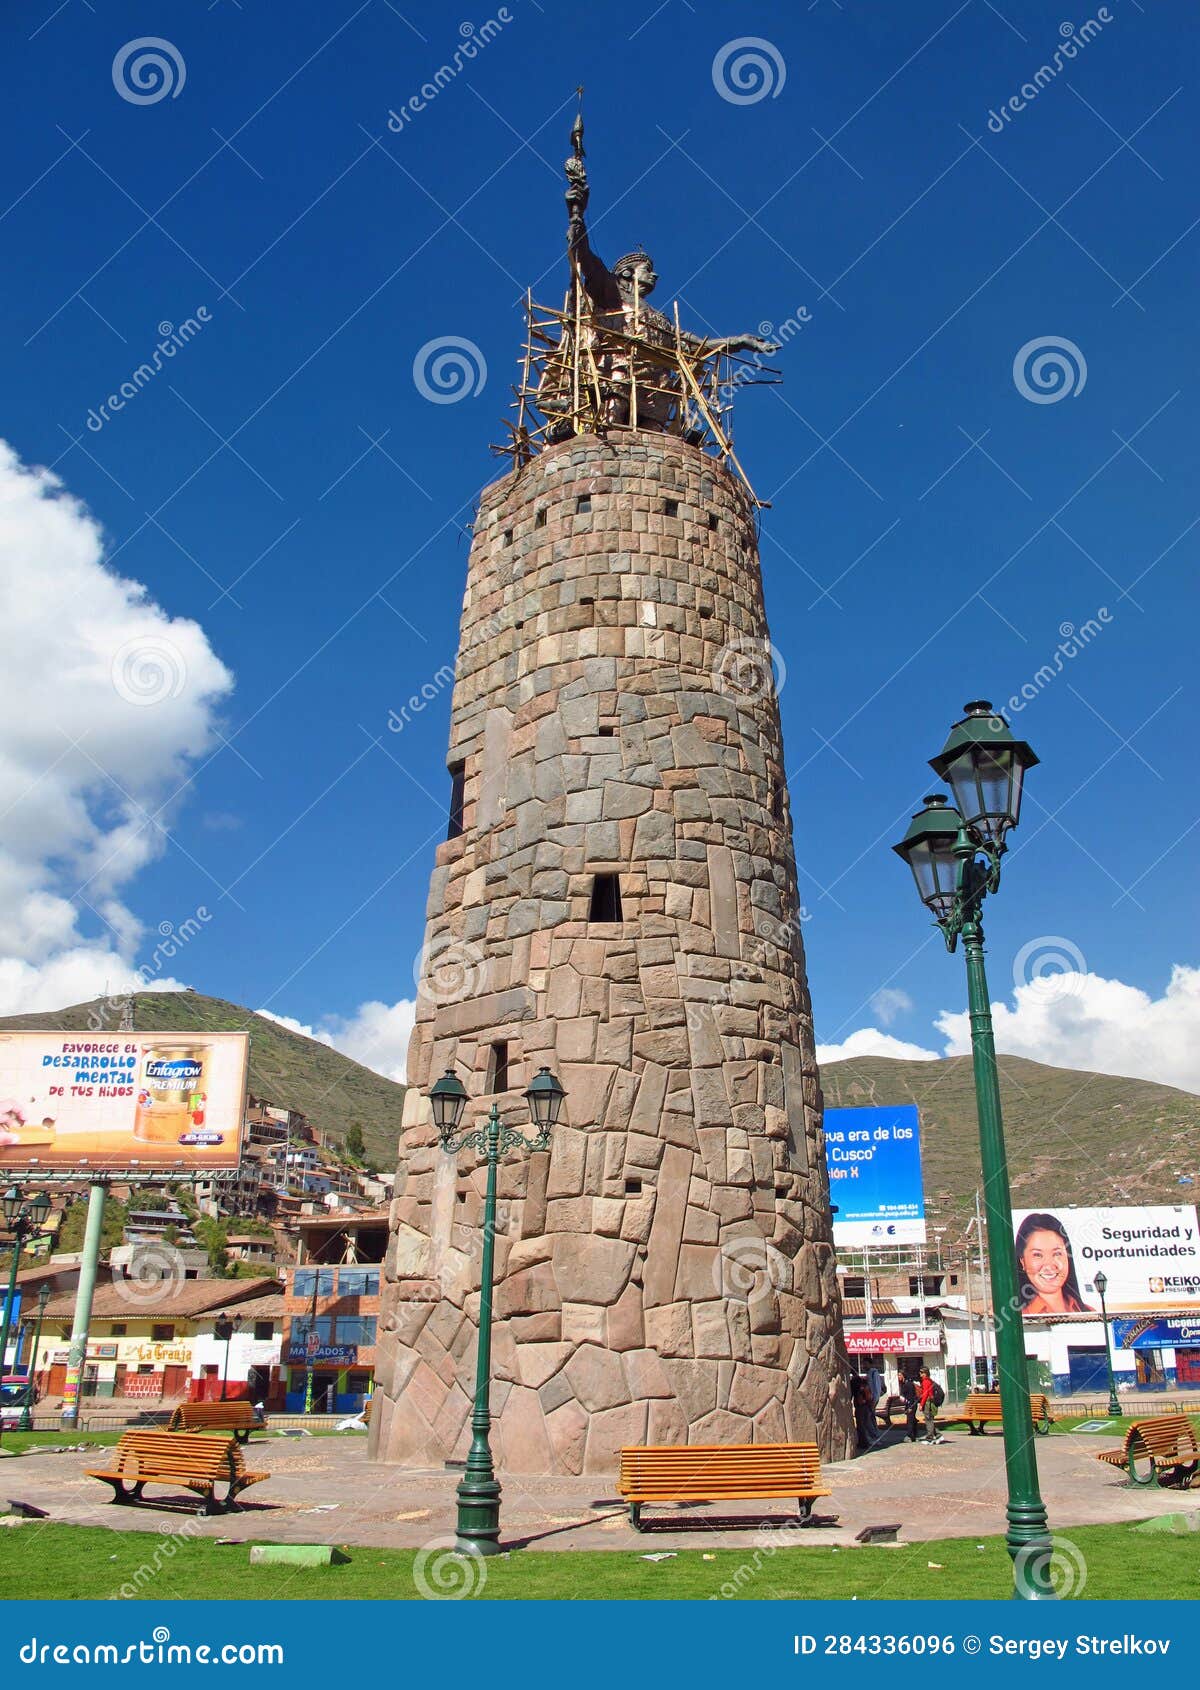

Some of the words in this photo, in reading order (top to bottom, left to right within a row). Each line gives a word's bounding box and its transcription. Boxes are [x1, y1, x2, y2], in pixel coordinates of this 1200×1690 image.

[147, 1063, 201, 1078] Enfagrow
[848, 1130, 870, 1141] era
[873, 1127, 889, 1140] de
[893, 1126, 913, 1139] los
[1102, 1226, 1180, 1242] Seguridad
[1184, 1228, 1193, 1240] y
[1082, 1244, 1196, 1261] Oportunidades
[1164, 1276, 1200, 1286] KEIKO
[844, 1332, 904, 1347] FARMACIAS
[138, 1344, 152, 1360] La
[154, 1344, 192, 1362] Granja
[290, 1347, 344, 1356] MATZADOS
